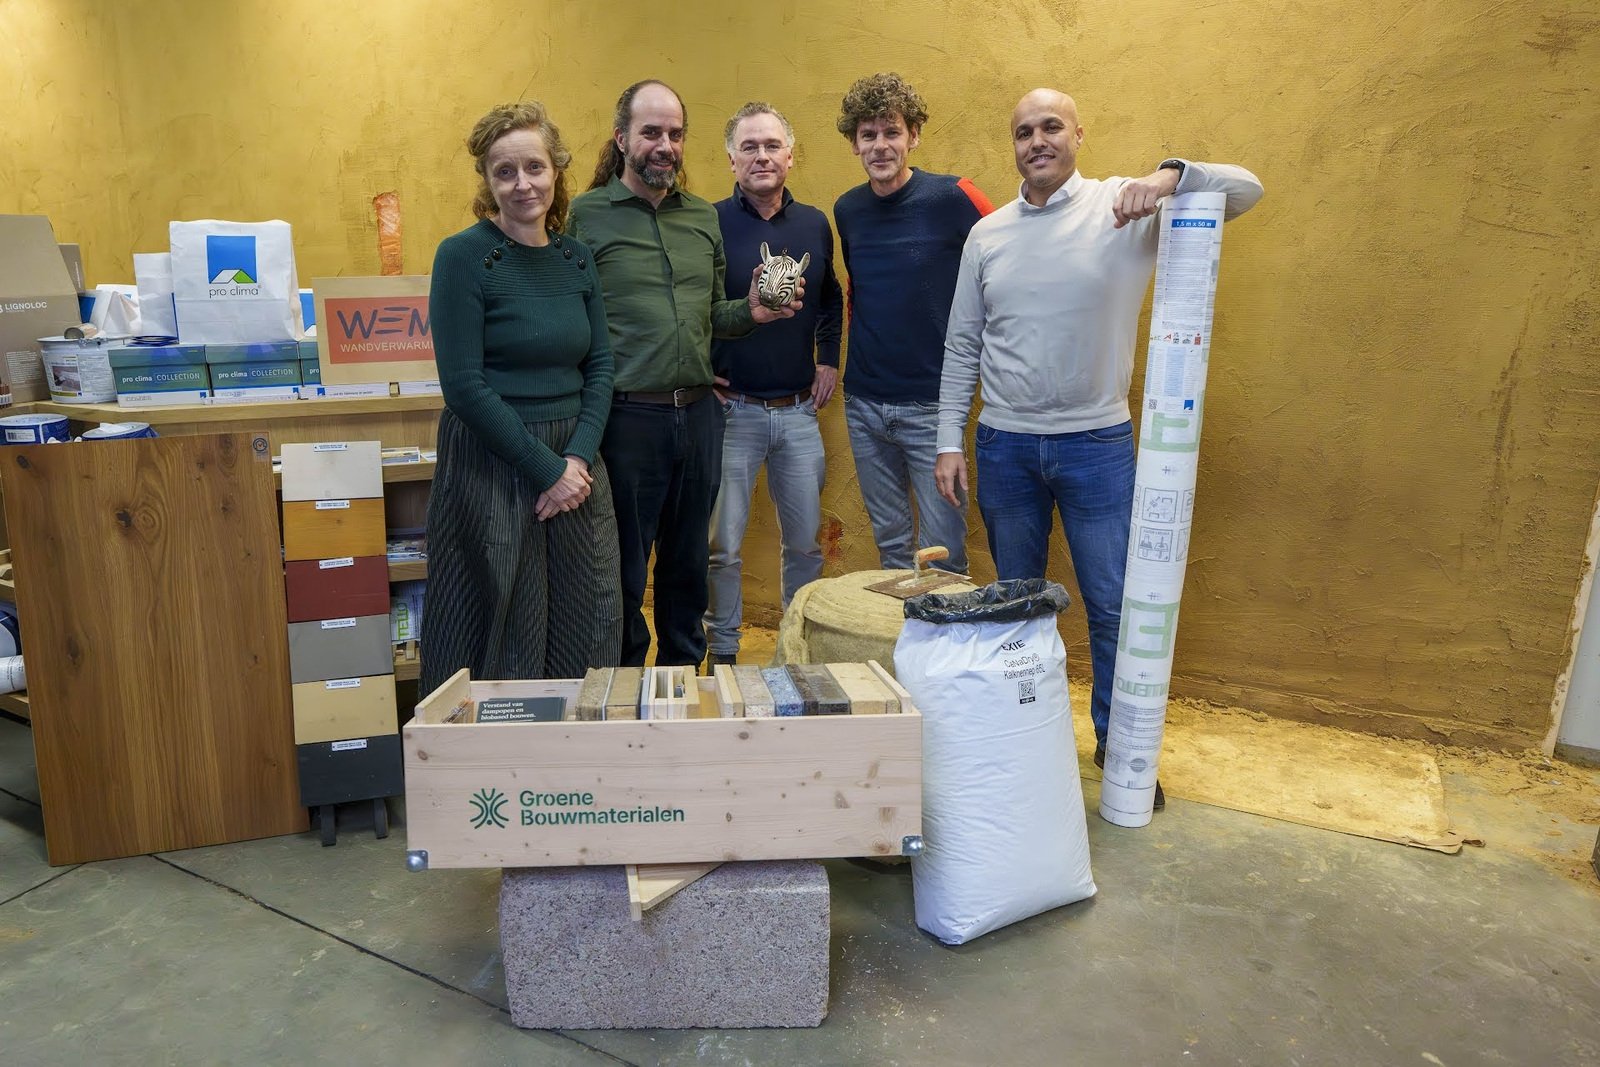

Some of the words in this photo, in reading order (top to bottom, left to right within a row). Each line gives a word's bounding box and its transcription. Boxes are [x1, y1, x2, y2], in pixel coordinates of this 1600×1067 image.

[209, 287, 227, 299] pro
[229, 285, 259, 296] clima
[5, 301, 47, 311] LIGNOLOC
[122, 376, 134, 384] pro
[156, 372, 200, 381] COLLECTION
[251, 369, 294, 377] COLLECTION
[483, 701, 511, 709] Verstand
[519, 790, 594, 807] Groene
[520, 806, 685, 826] Bouwmaterialen
